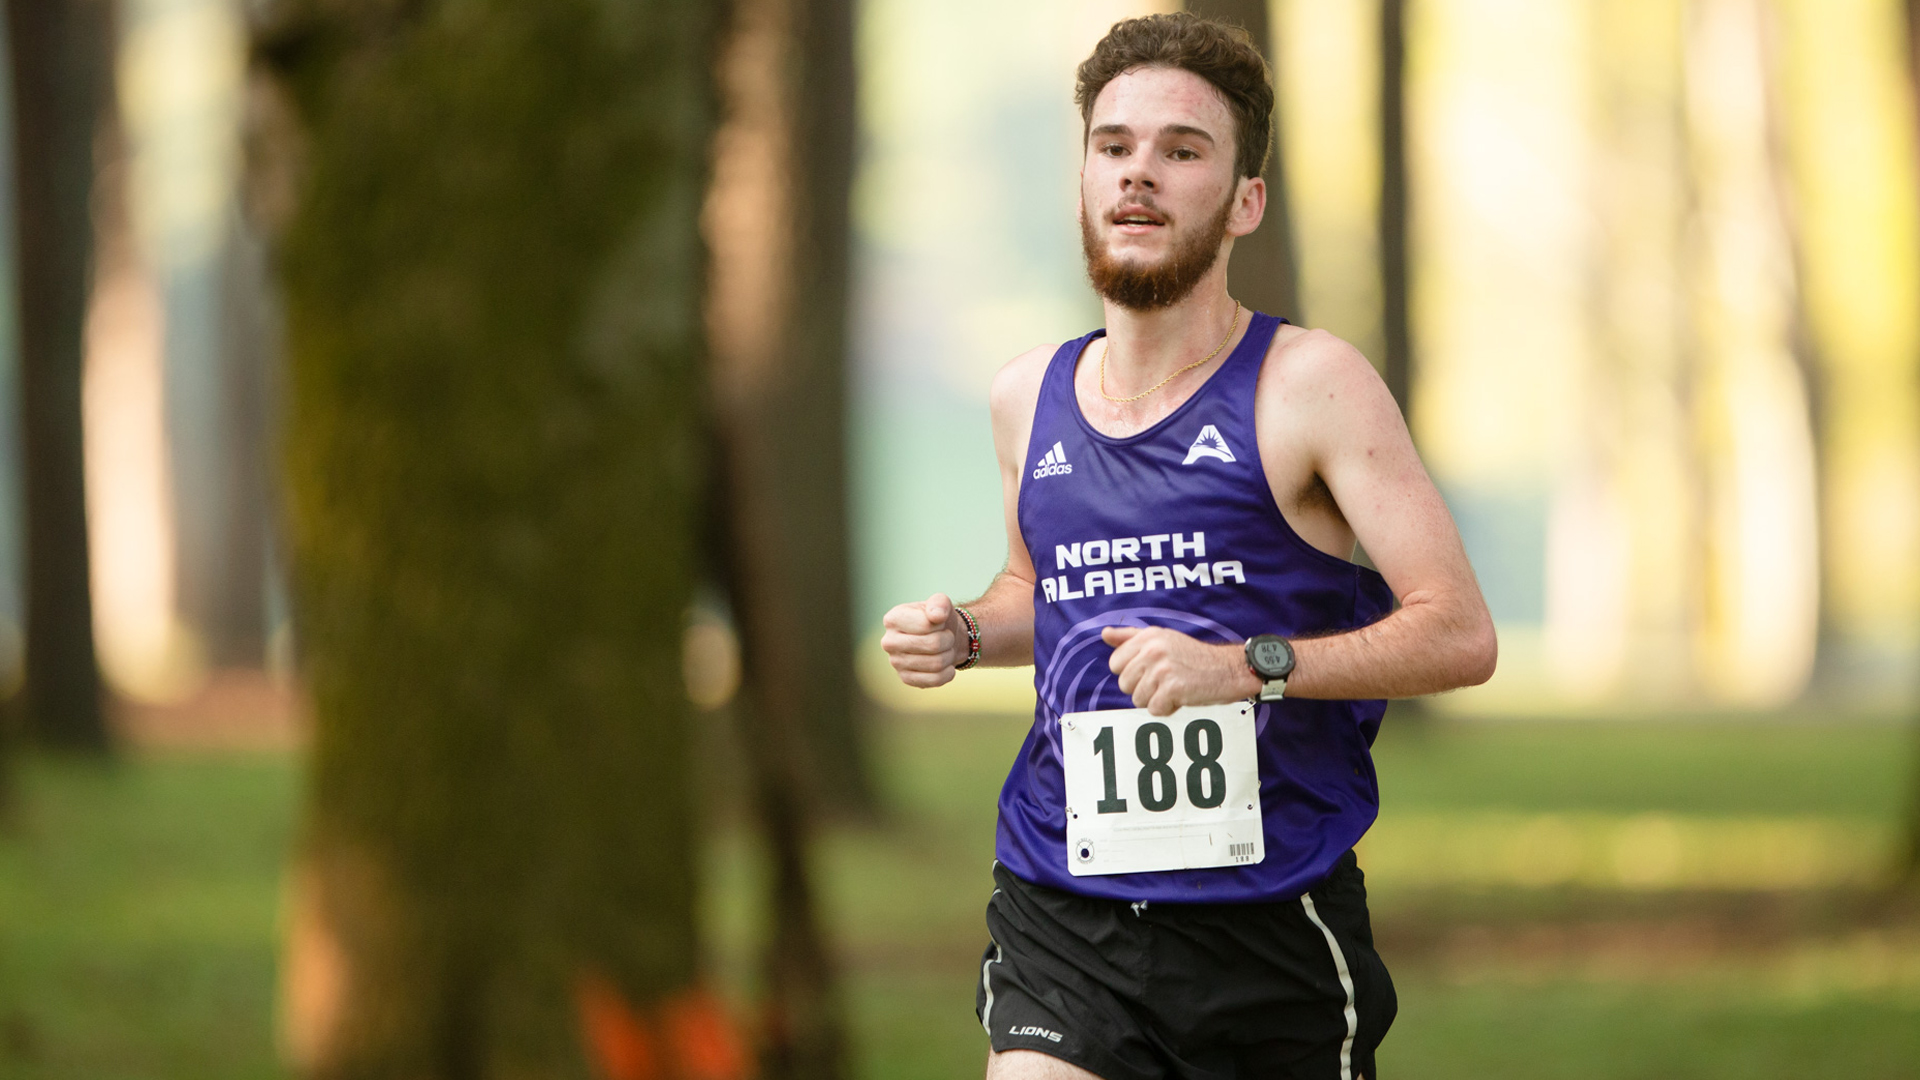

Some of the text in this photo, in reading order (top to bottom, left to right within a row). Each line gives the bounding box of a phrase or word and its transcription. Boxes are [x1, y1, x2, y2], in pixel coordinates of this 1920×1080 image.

[1033, 463, 1073, 480] adidas
[1055, 531, 1206, 570] NORTH
[1041, 560, 1246, 604] ALABAMA
[1093, 719, 1227, 815] 188
[1008, 1025, 1063, 1043] LIONS
